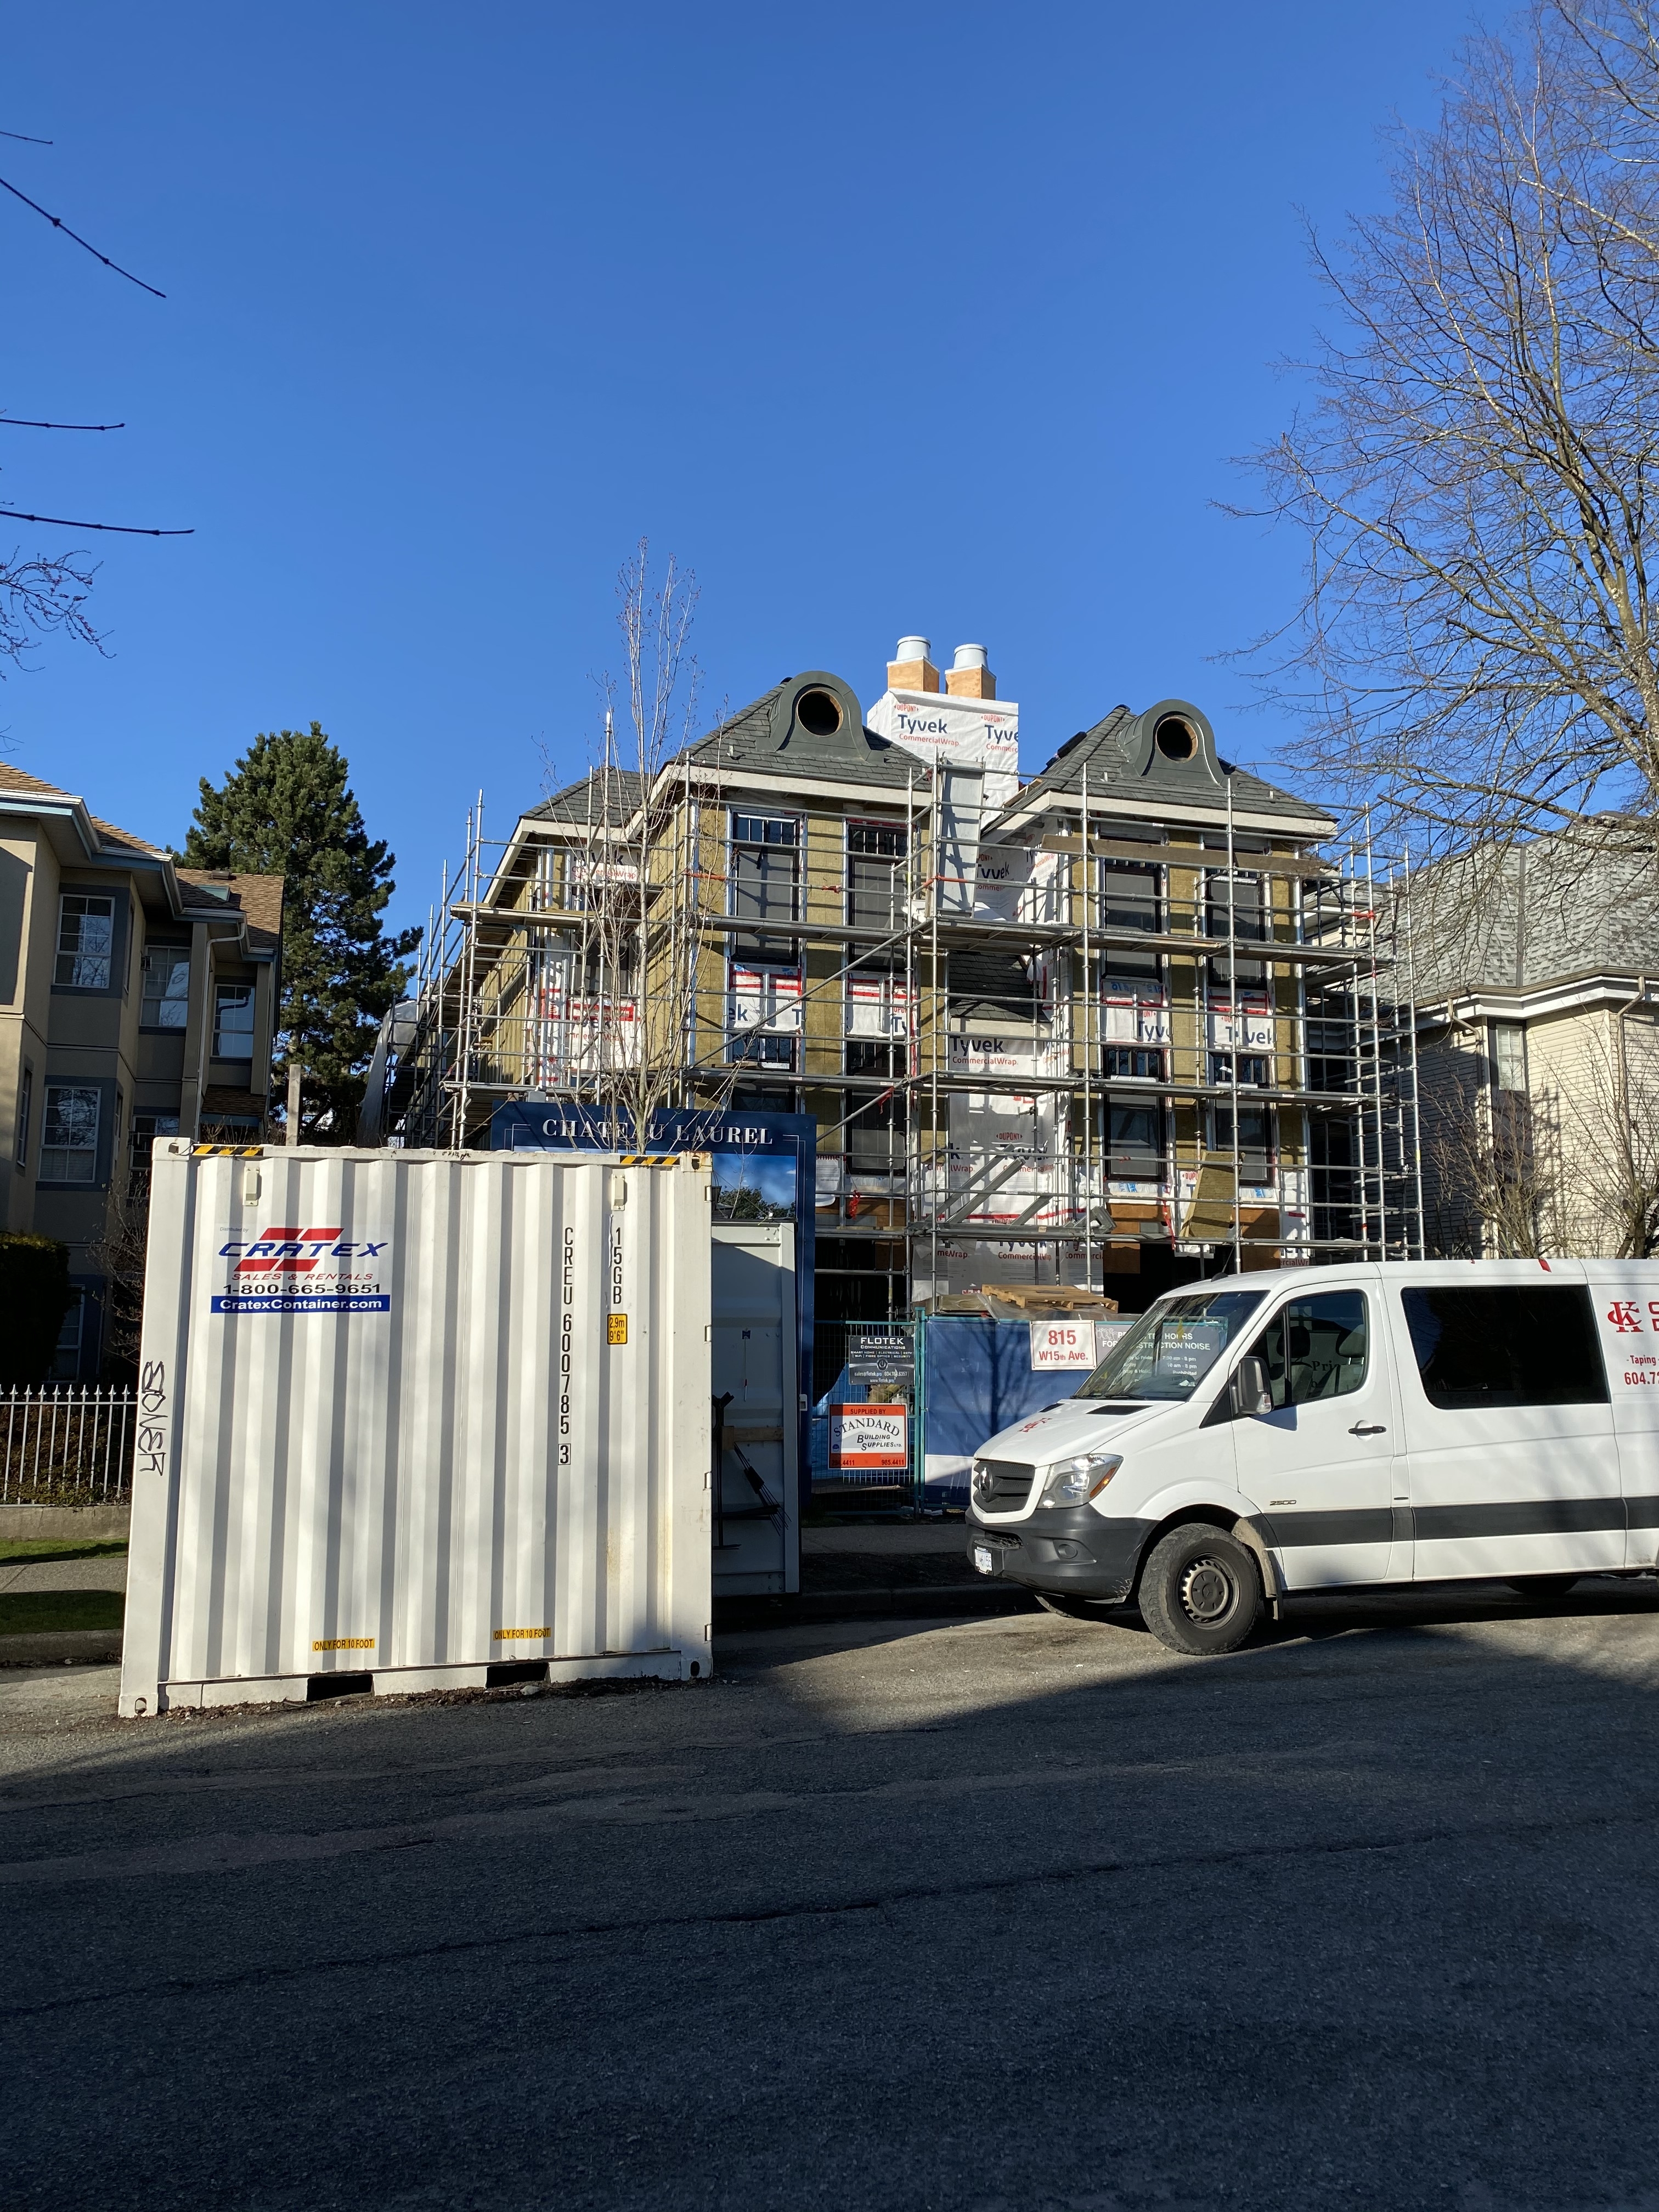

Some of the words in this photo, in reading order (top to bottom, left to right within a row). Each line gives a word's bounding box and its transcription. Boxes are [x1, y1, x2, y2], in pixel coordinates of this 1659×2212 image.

[897, 704, 917, 712] DUPONT
[898, 714, 949, 734] Tyvek
[984, 714, 1003, 723] DUPONT
[899, 733, 960, 747] CommercialWrap
[950, 1035, 1005, 1057] Tyvek
[952, 1056, 1017, 1066] CommercialWrap
[676, 1124, 774, 1144] LAUREL
[998, 1132, 1020, 1141] DUPONT
[218, 1242, 388, 1257] CRATEX
[223, 1283, 381, 1295] 1-800-665-9651
[220, 1299, 382, 1311] CratexContainer.com
[860, 1337, 904, 1345] FLOTEK
[1048, 1329, 1076, 1345] 815
[1039, 1350, 1066, 1361] W15th
[1068, 1351, 1088, 1361] Ave.
[1630, 1355, 1656, 1366] Taping
[833, 1418, 900, 1437] STANDARD
[857, 1435, 890, 1443] BUILDING
[861, 1442, 894, 1451] SUPPLIES
[512, 1629, 524, 1639] FOR
[314, 1641, 331, 1651] ONLY
[332, 1639, 346, 1650] FOR
[348, 1639, 354, 1649] 10
[356, 1639, 373, 1648] FOOT
